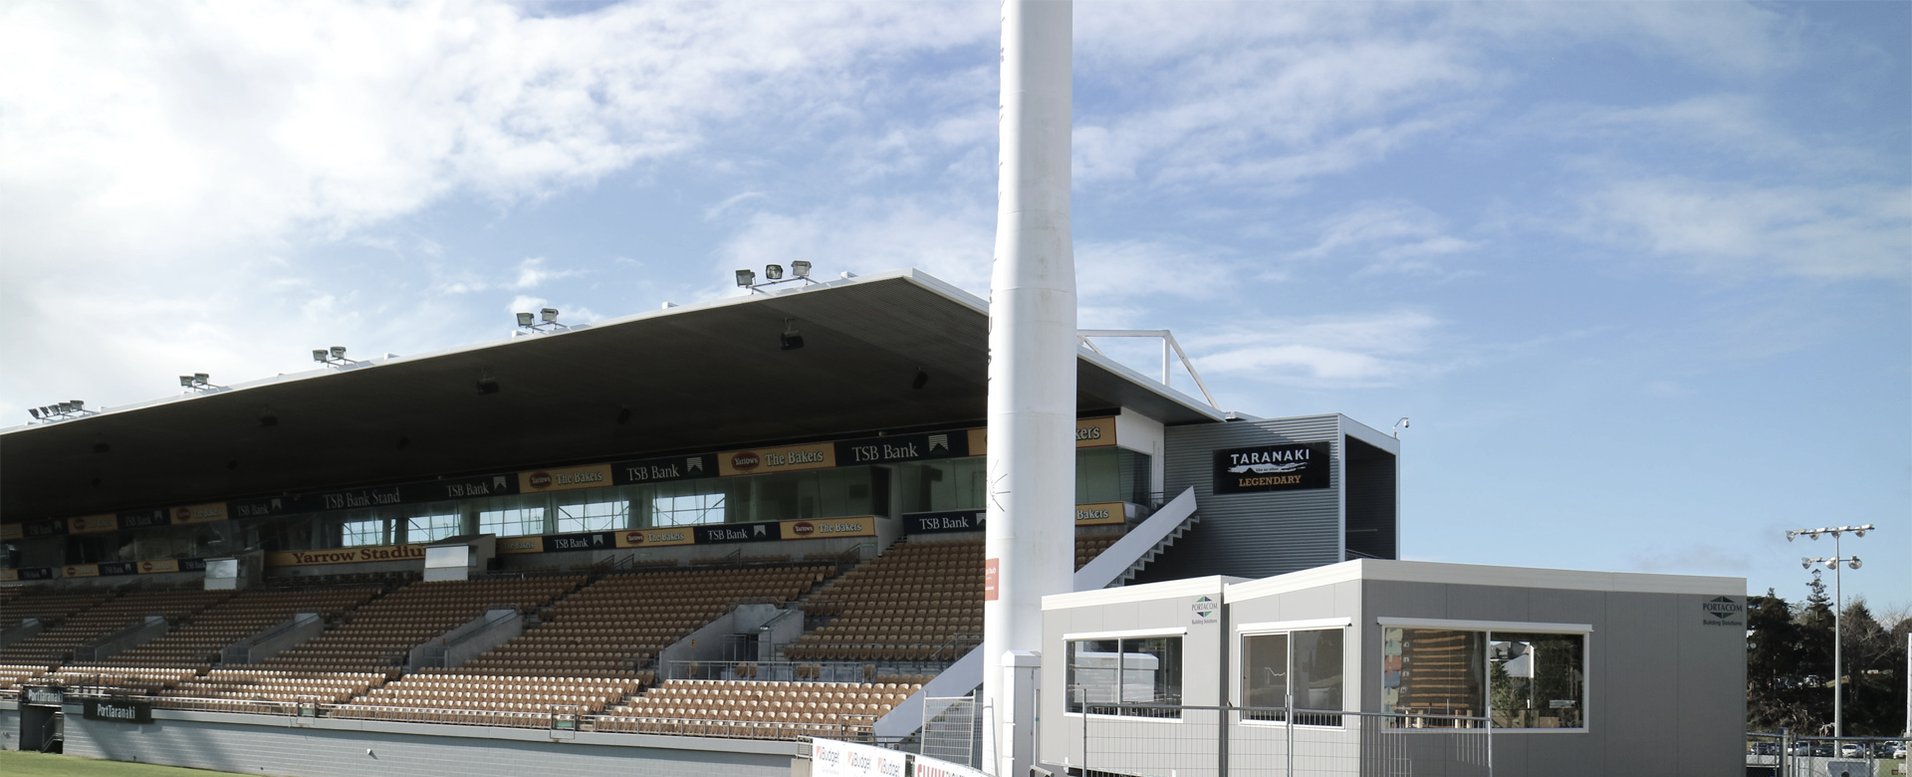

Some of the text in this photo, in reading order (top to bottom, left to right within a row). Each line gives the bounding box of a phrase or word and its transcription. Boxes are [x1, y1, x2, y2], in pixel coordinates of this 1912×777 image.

[1075, 427, 1101, 440] kers
[764, 450, 823, 467] The Bakers
[851, 442, 919, 462] TSB Bank
[1230, 449, 1310, 464] TARANAKI
[557, 471, 603, 485] The Bakers
[626, 464, 680, 481] TSB Bank
[1239, 475, 1301, 487] LEGENDARY
[446, 481, 489, 497] TSB Bank
[323, 487, 401, 509] TSB Bank Stand
[1076, 509, 1109, 520] Bakers
[818, 521, 862, 533] The Bakers
[919, 516, 969, 530] TSB Bank
[708, 528, 748, 541] TSB Bank
[554, 537, 590, 549] TSB Bank
[292, 545, 424, 564] Yarrow Stadiu
[1703, 602, 1743, 612] PORTACOM
[97, 703, 136, 719] PortTaranaki
[819, 746, 840, 767] Budget
[851, 752, 872, 774] Budget
